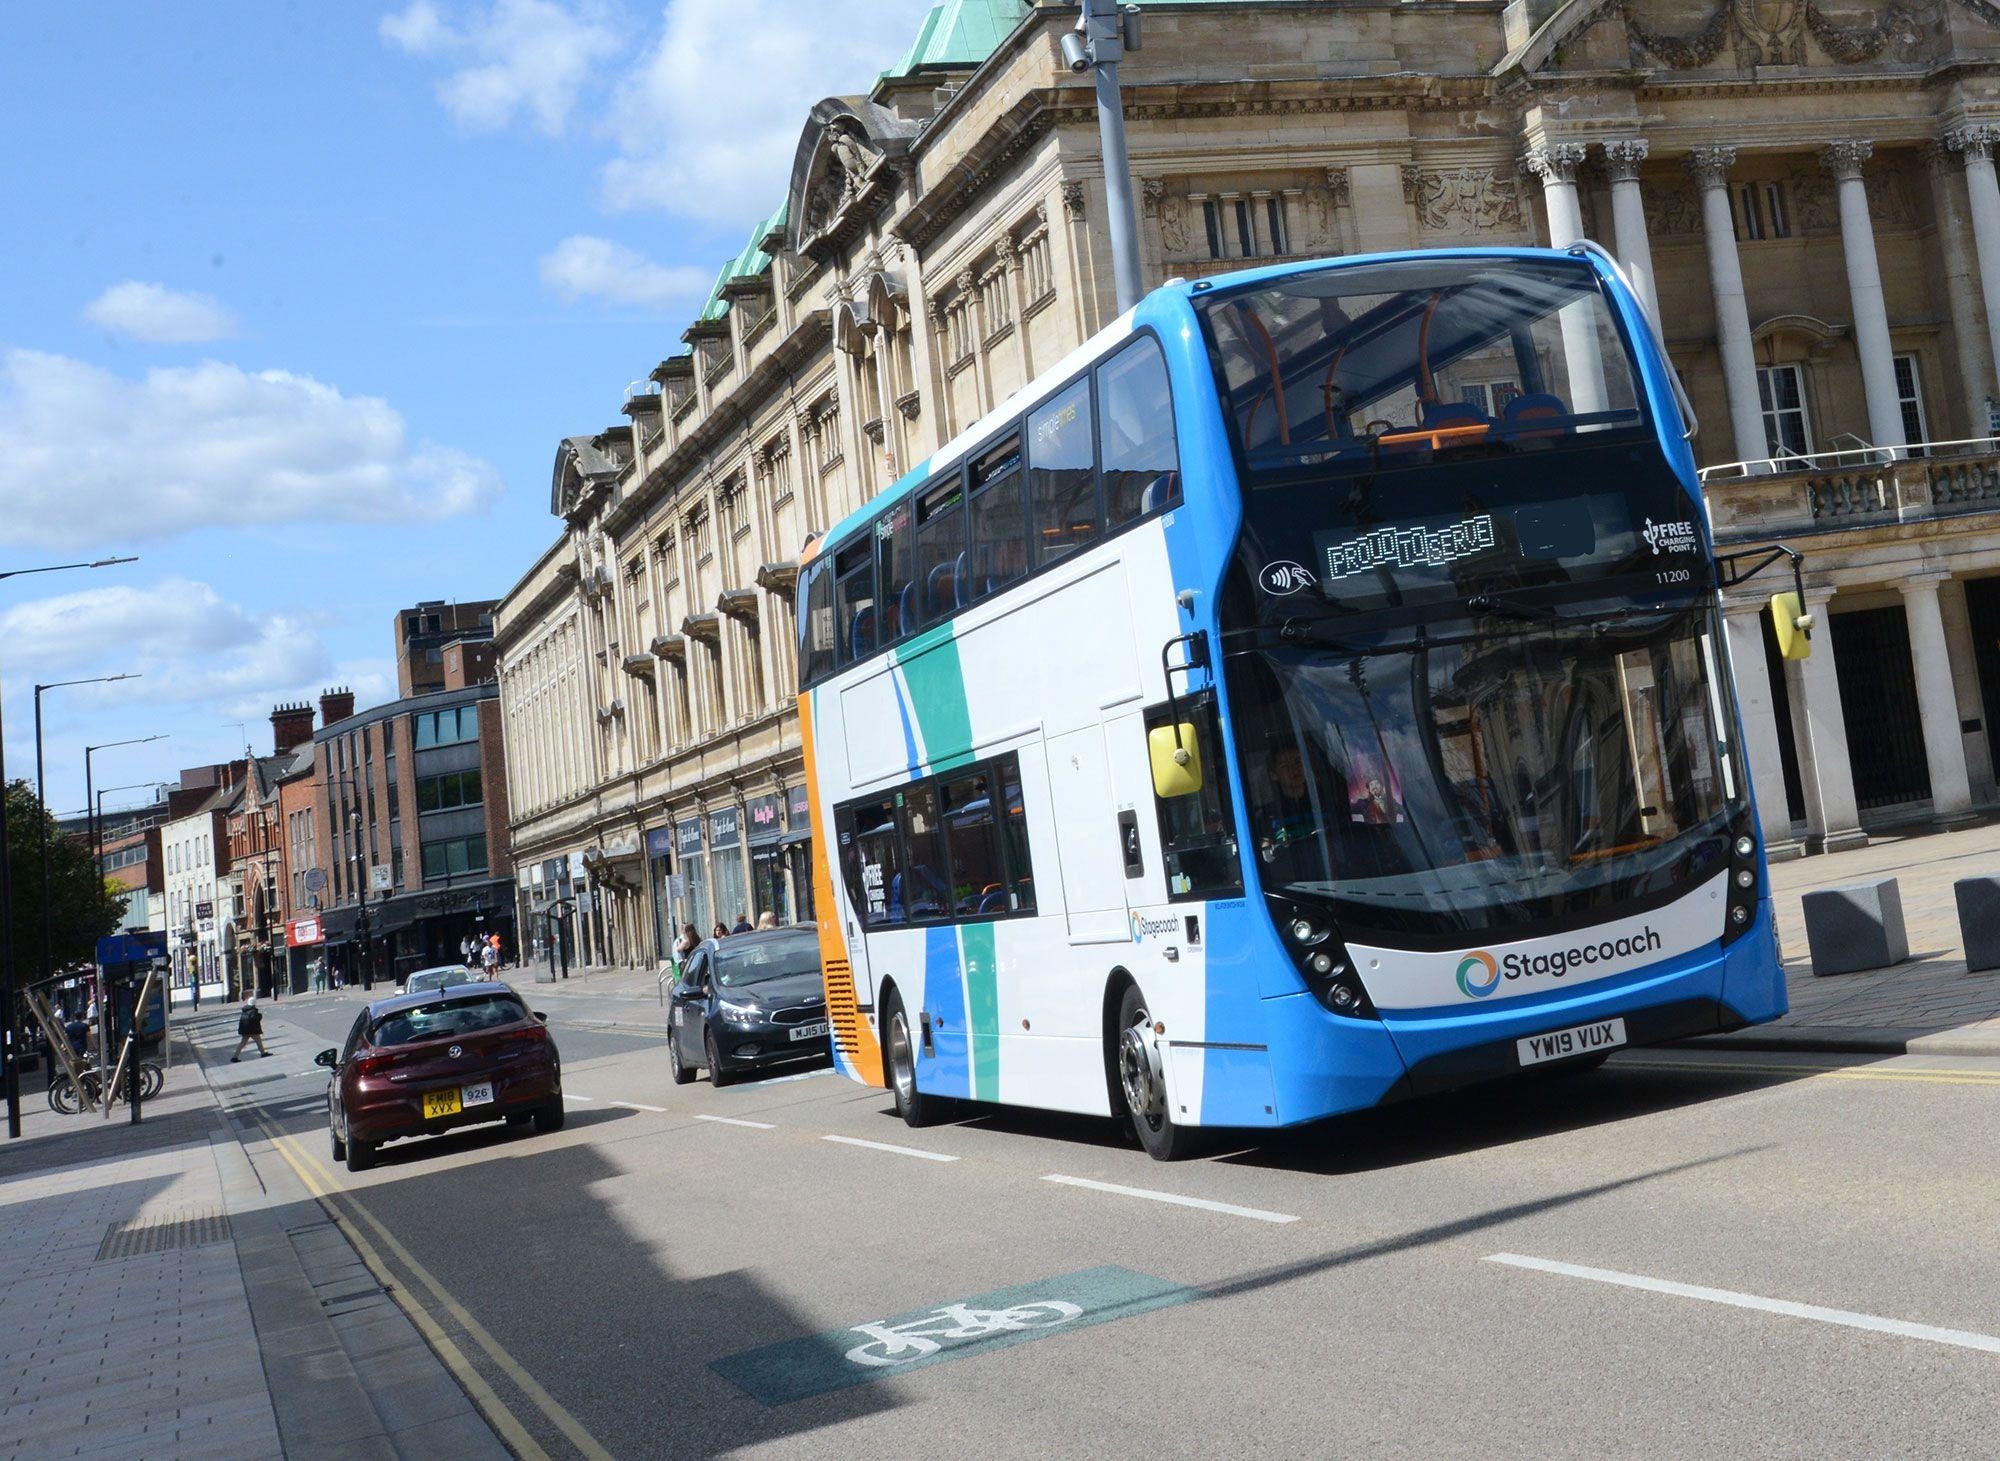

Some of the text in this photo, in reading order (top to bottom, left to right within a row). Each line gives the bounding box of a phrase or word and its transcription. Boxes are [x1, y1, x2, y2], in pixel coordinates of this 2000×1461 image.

[1659, 521, 1693, 538] FREE
[1330, 518, 1492, 577] PROUD TO SERVE
[1658, 535, 1696, 547] CHARGING
[1668, 543, 1691, 553] POINT
[1656, 569, 1690, 584] 11200
[866, 863, 883, 887] FREE
[1141, 912, 1179, 939] Stagecoach
[1503, 925, 1661, 980] Stagecoach
[795, 1025, 817, 1038] MJ15
[1530, 1023, 1615, 1059] YW19 VUX
[467, 1088, 488, 1100] 926
[431, 1102, 454, 1115] XVX
